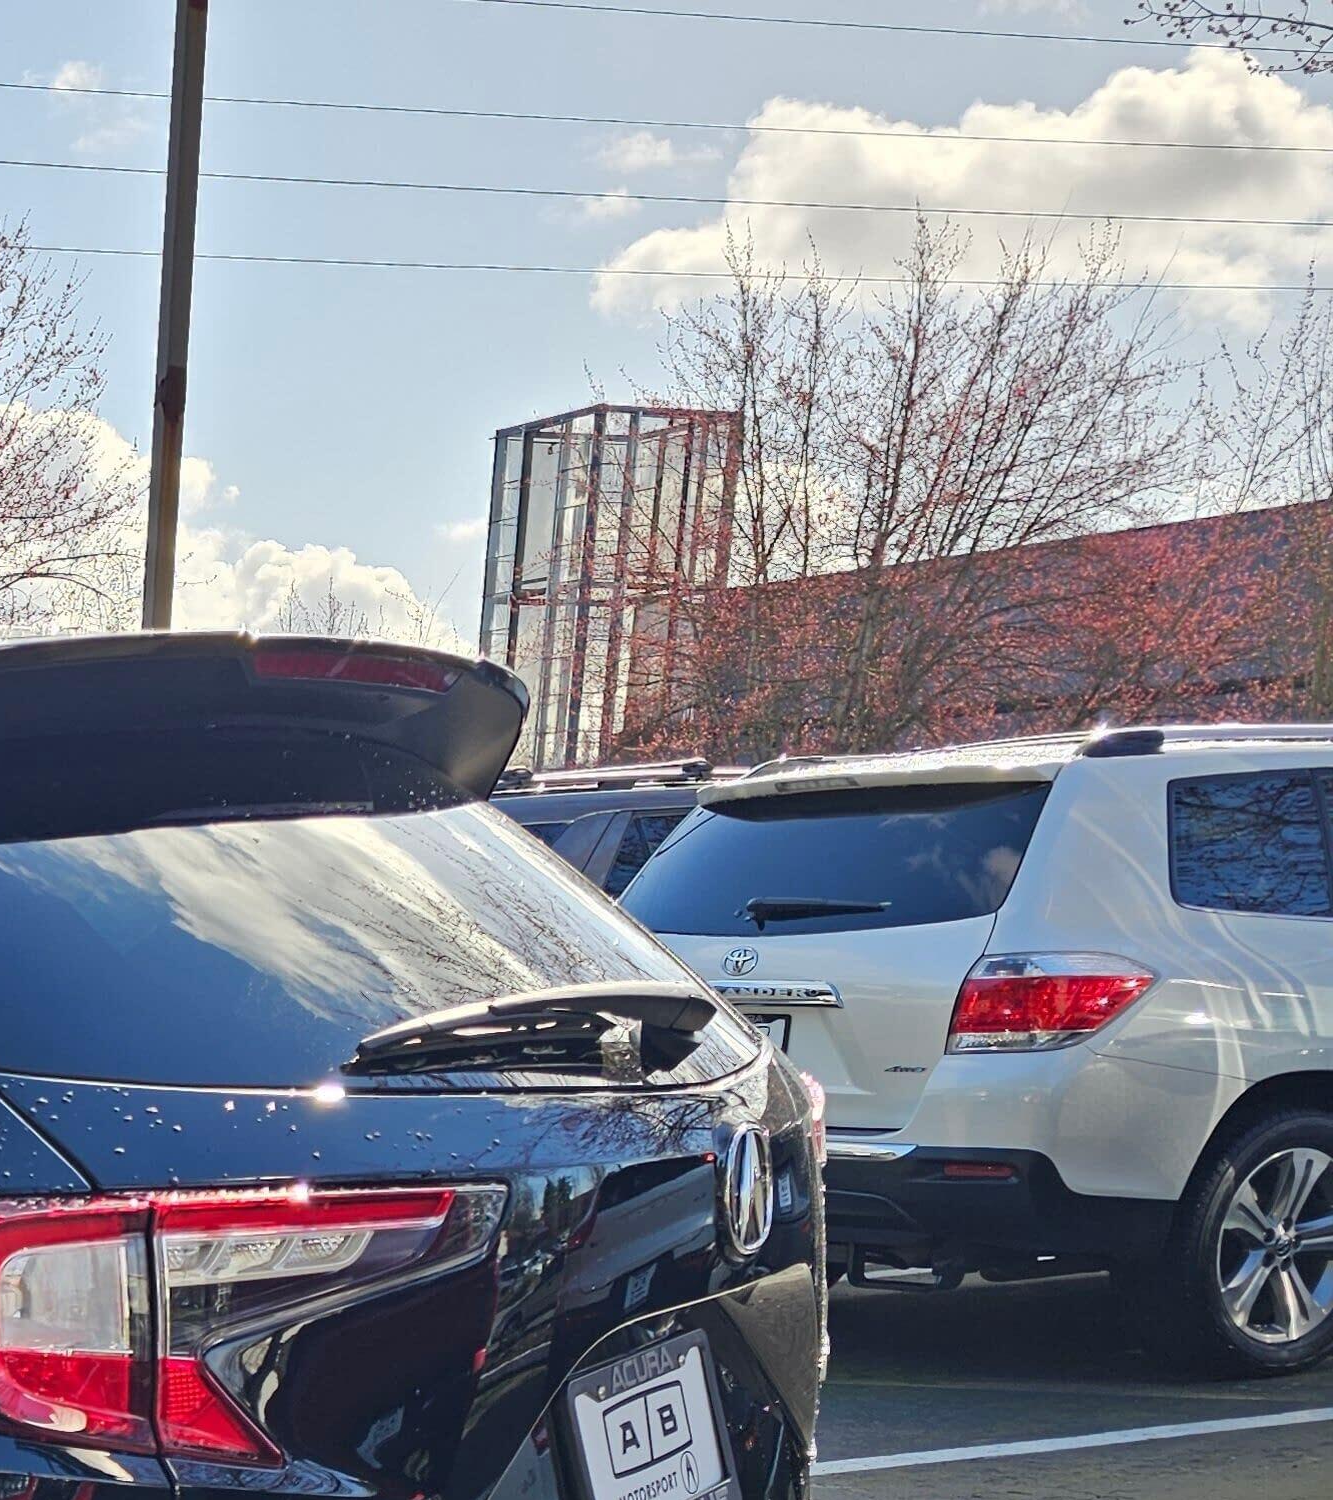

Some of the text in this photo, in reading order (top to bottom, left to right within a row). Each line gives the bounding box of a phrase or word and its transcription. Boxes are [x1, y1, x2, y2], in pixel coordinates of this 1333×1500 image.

[611, 1346, 676, 1394] ACURA
[619, 1403, 679, 1455] A B
